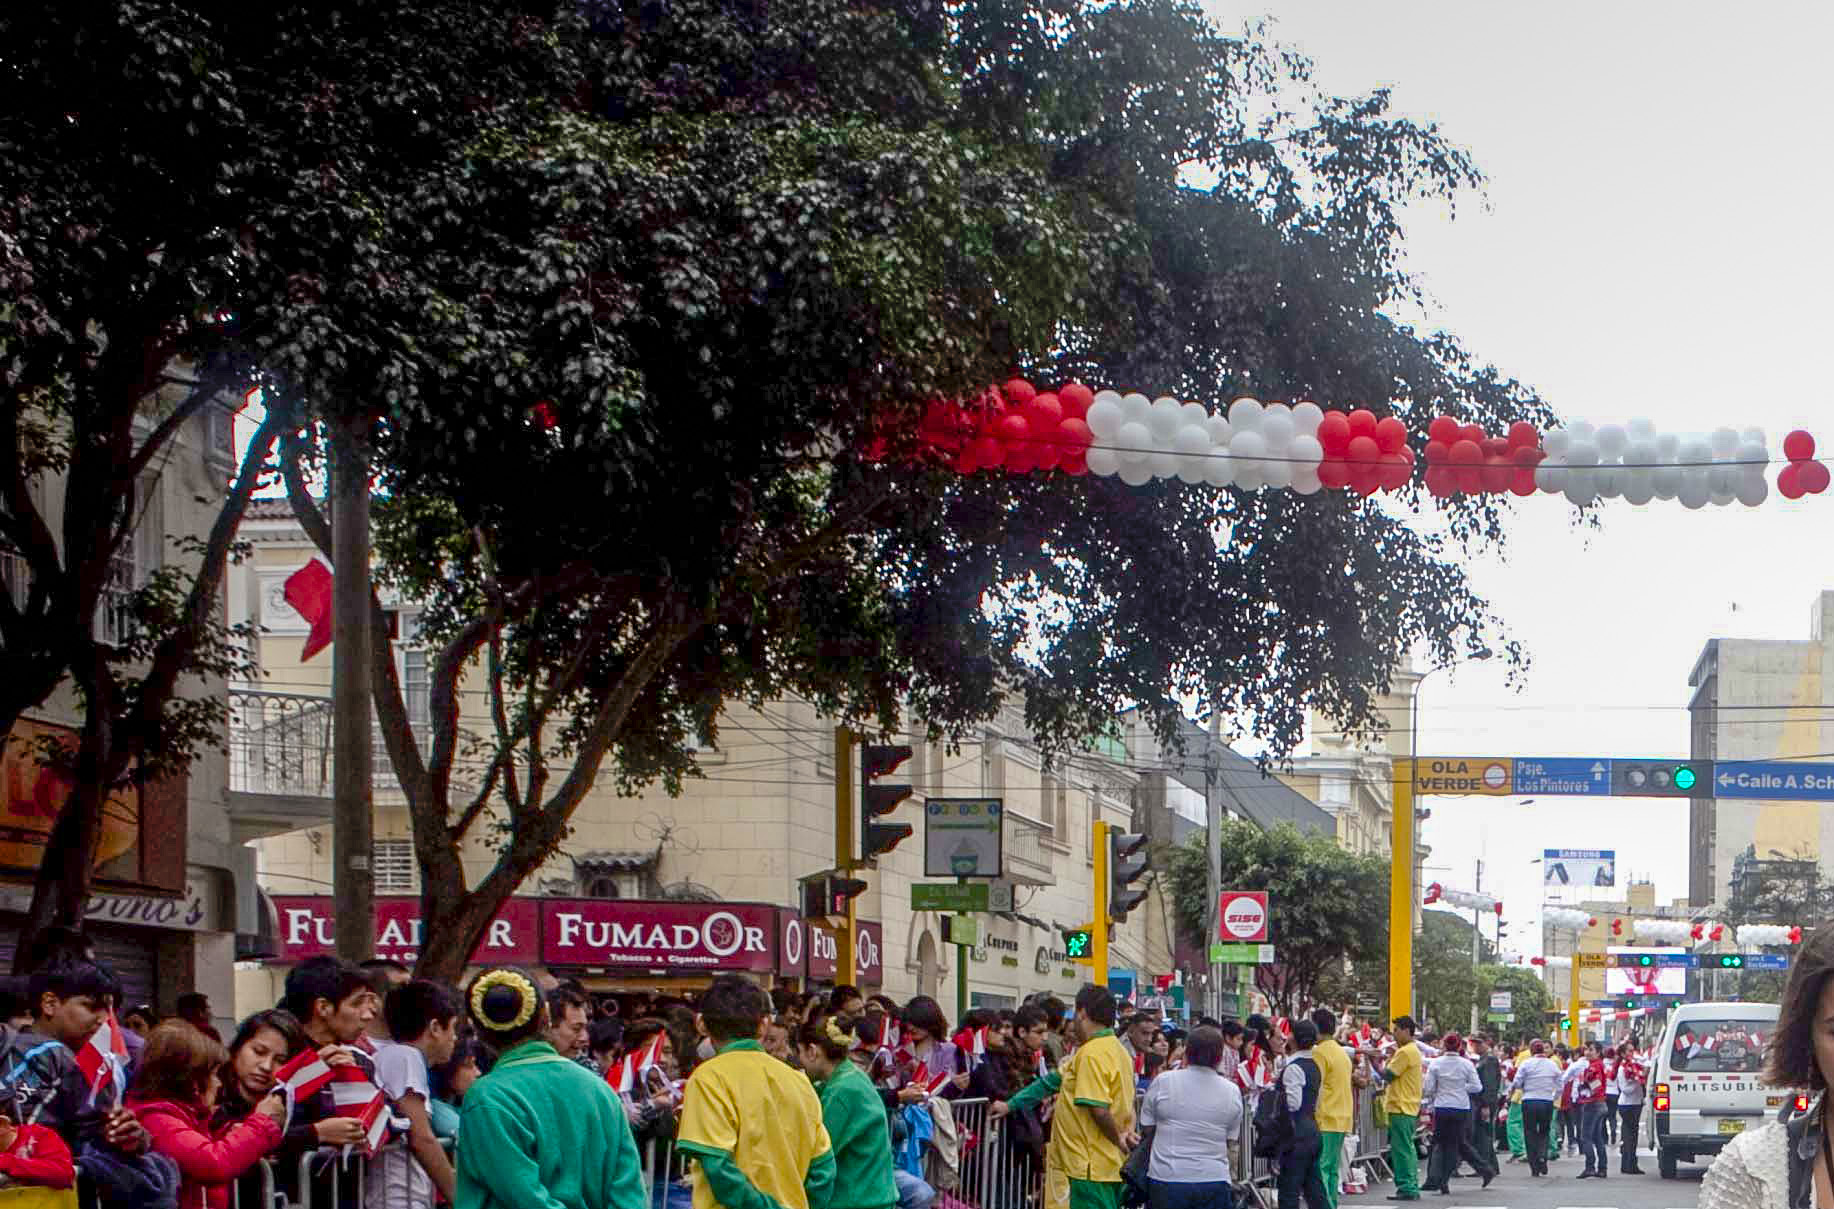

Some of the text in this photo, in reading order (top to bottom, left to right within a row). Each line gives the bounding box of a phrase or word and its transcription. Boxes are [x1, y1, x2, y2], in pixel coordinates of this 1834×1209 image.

[1432, 761, 1469, 774] OLA
[1517, 761, 1547, 776] Psje.
[1420, 777, 1481, 790] VERDE
[1517, 778, 1590, 793] Los Pintores
[1737, 773, 1782, 789] Calle
[556, 911, 768, 957] FUMADOR
[1676, 1082, 1772, 1093] MITSUBIS
